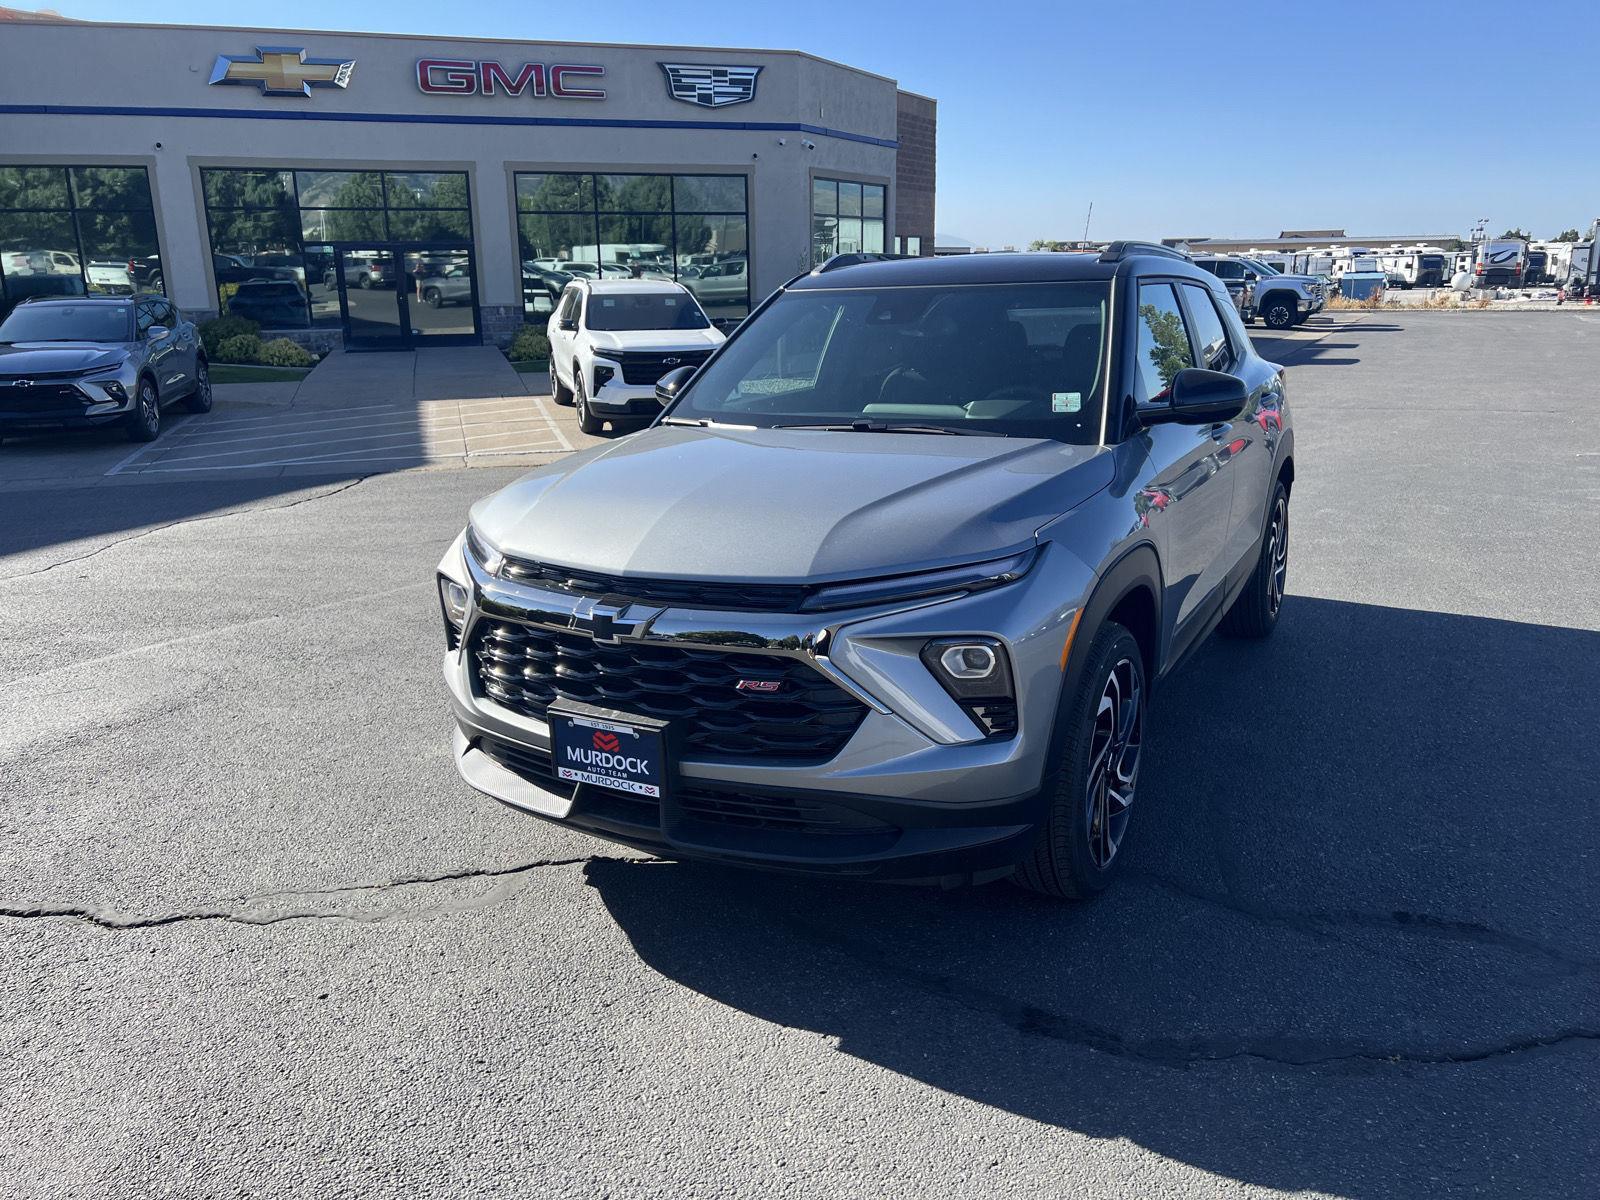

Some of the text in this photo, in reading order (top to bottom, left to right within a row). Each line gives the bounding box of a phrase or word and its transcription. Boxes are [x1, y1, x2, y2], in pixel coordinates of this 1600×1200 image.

[415, 57, 606, 100] GMC
[735, 679, 781, 691] RS
[566, 745, 650, 775] MURDOCK
[587, 766, 628, 778] AUTO TEAM
[581, 773, 637, 792] MURDOCK
